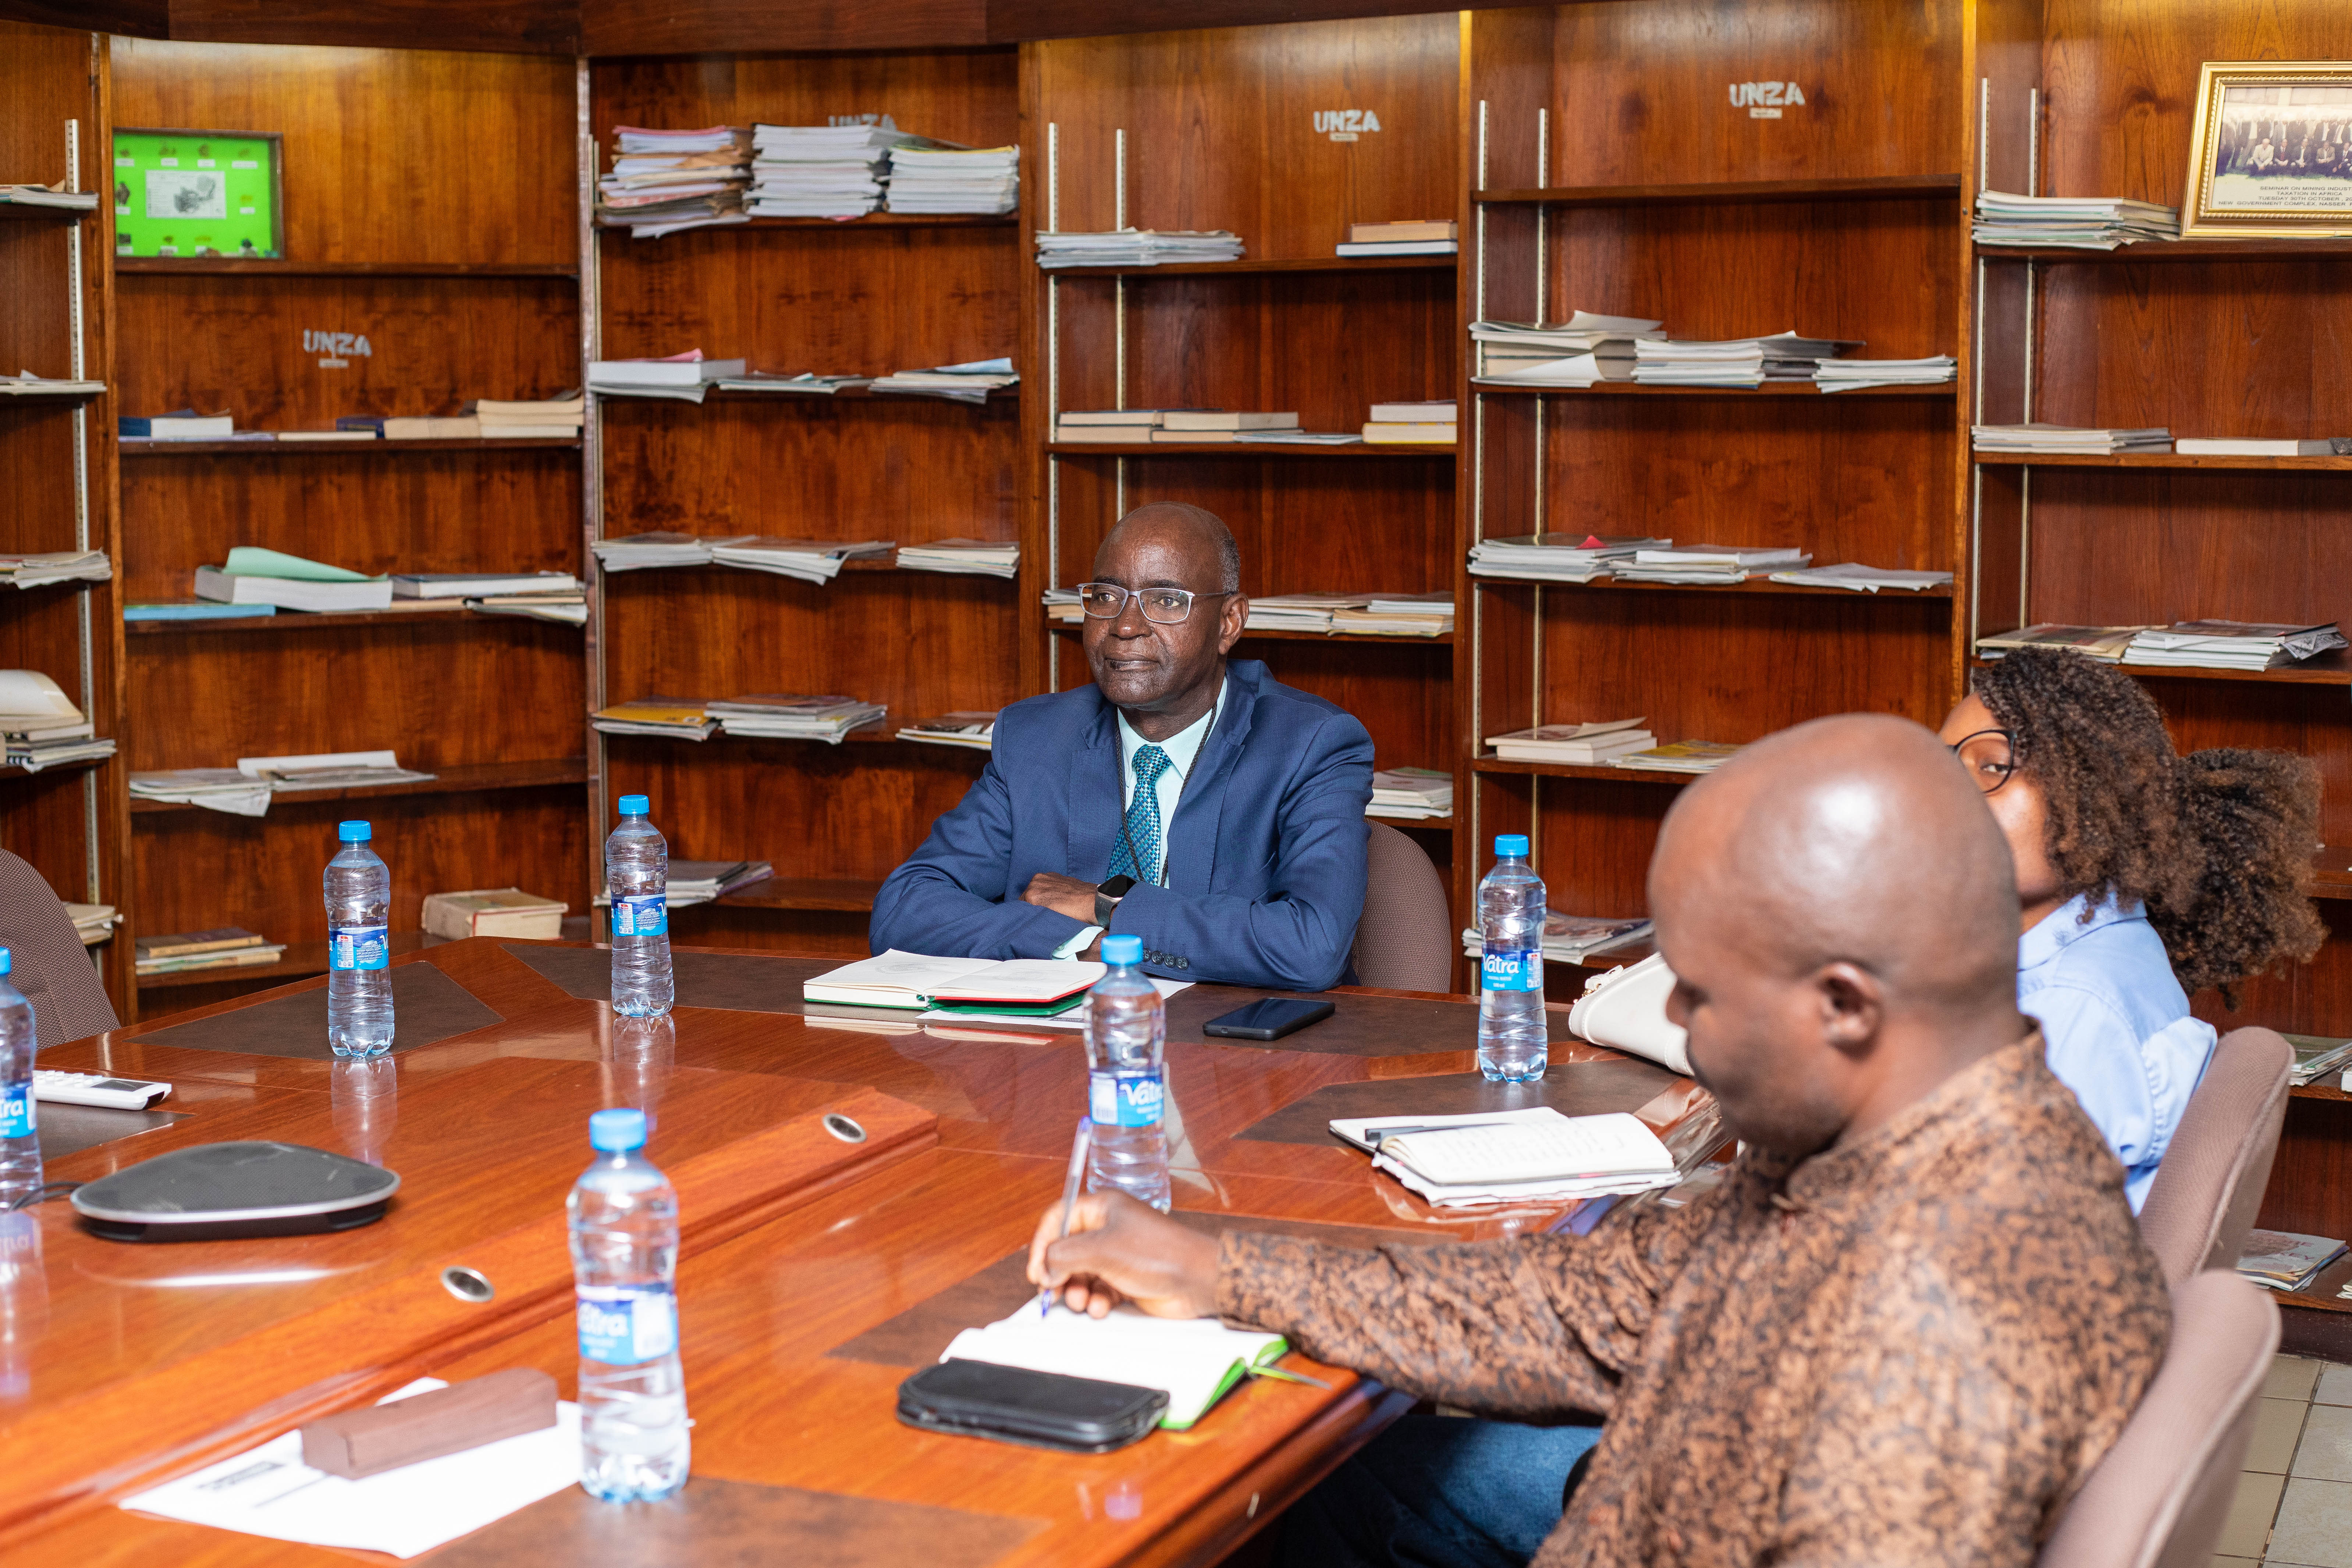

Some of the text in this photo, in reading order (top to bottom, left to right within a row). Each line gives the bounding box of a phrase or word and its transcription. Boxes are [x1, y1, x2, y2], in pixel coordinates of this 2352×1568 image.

[1729, 81, 1805, 107] UNZA
[1313, 109, 1382, 133] UNZA
[303, 329, 372, 357] UNZA
[1482, 953, 1519, 974] Vatra
[1119, 1081, 1163, 1106] Vatr
